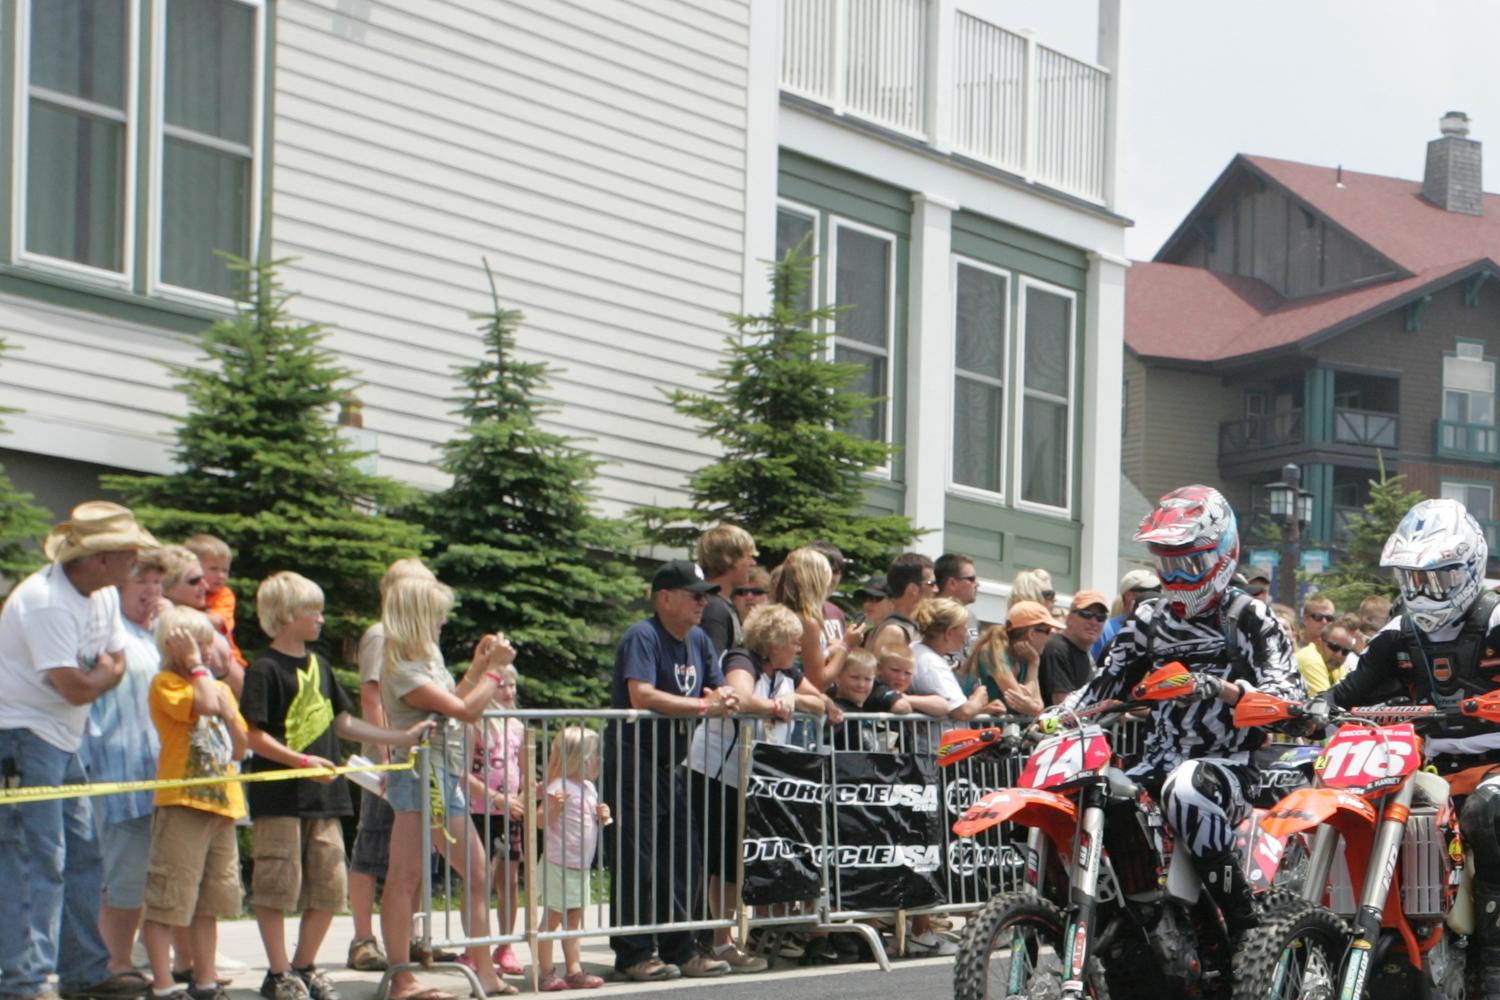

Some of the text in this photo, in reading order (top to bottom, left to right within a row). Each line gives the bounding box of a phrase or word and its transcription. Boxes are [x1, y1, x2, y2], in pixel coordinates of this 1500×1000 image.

[1032, 737, 1092, 788] 14
[1321, 740, 1412, 779] 116
[1259, 833, 1283, 866] 14
